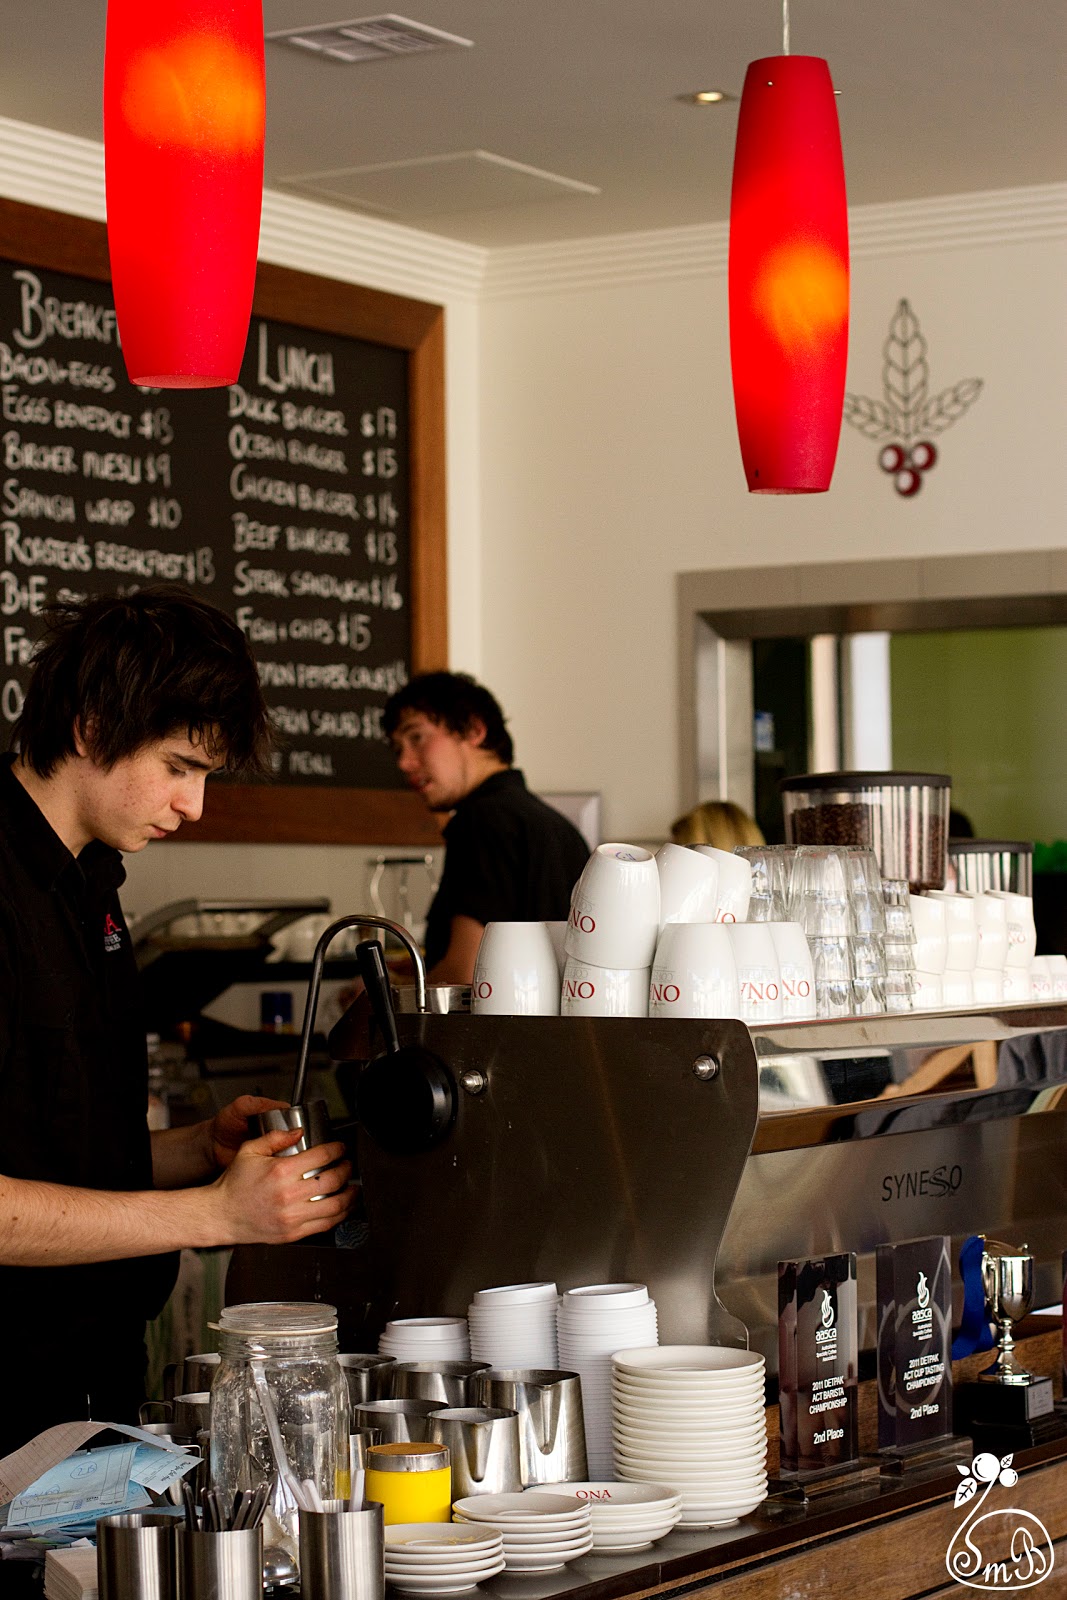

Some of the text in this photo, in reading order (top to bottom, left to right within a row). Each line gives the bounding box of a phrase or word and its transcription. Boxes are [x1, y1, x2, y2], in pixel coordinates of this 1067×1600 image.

[12, 270, 121, 349] BREAKF
[258, 322, 334, 396] LUNCH
[2, 385, 51, 425] EGGS
[54, 400, 132, 439] BENEDICT
[3, 430, 78, 474] BIRCHER
[145, 453, 171, 487] $9
[148, 498, 182, 529] $10
[650, 982, 681, 1003] ON
[881, 1164, 962, 1201] SYNESSO
[909, 1353, 940, 1368] 2011 DETPAK
[903, 1362, 945, 1381] ACT CUP TASTING
[812, 1375, 844, 1391] 2011 DETPAK
[906, 1374, 943, 1391] CHAMPIONSHIP
[812, 1387, 845, 1403] ACT BARISTA
[809, 1397, 848, 1414] CHAMPIONSHIP
[910, 1403, 939, 1419] 2nd Place
[813, 1427, 844, 1444] 2nd Place
[576, 1490, 612, 1500] ONA
